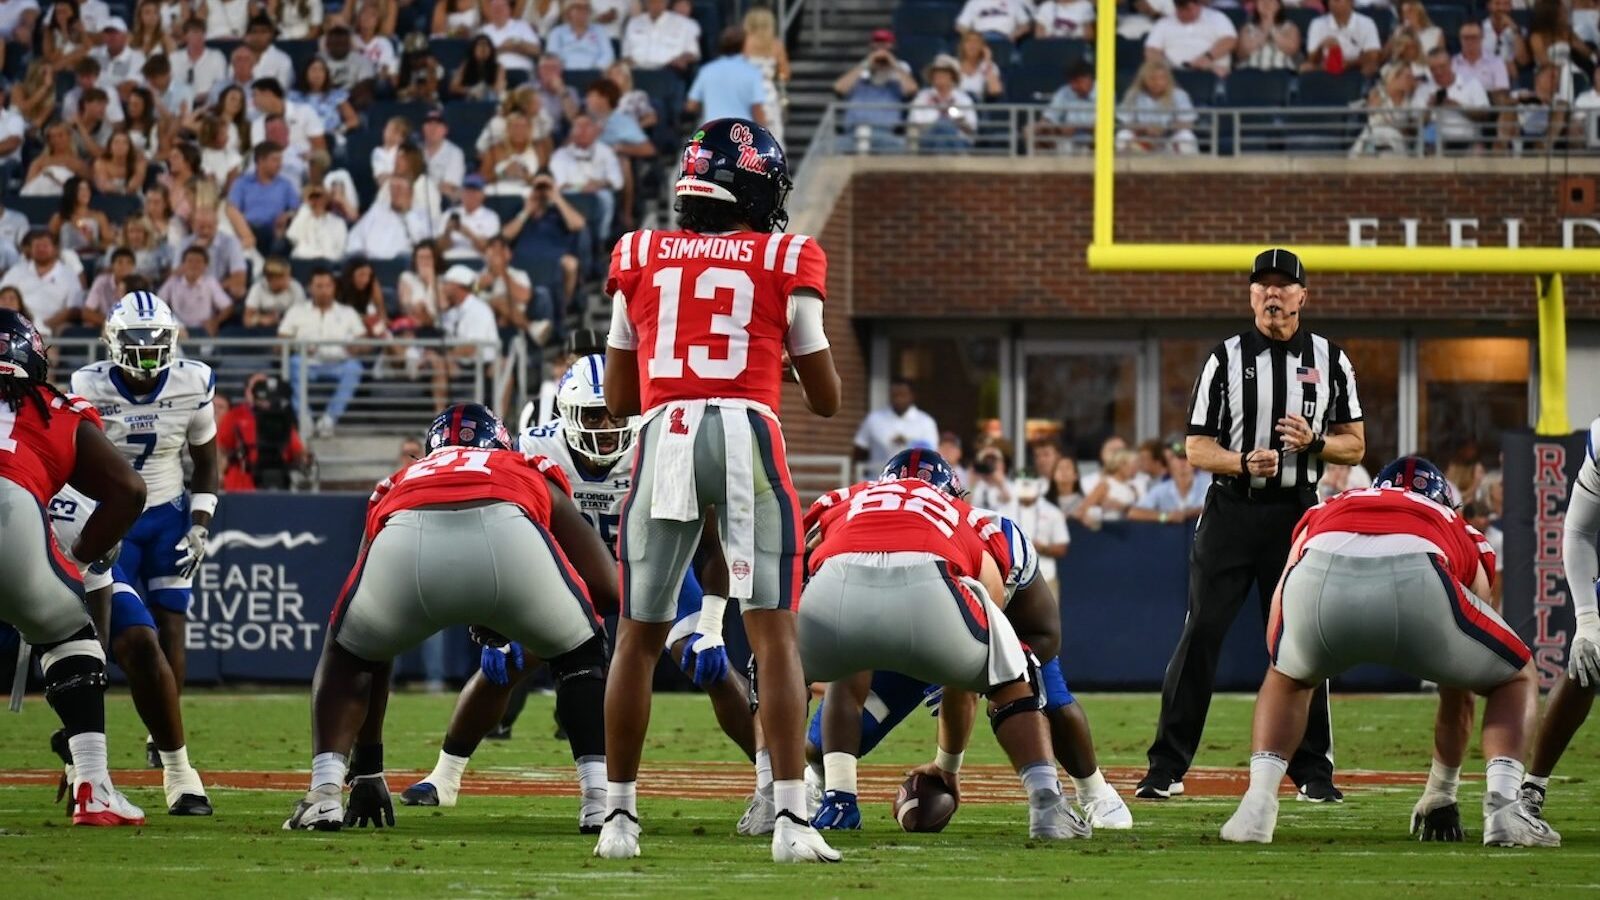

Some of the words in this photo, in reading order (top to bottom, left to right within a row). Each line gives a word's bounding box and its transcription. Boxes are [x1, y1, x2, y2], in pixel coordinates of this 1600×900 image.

[730, 123, 754, 145] Ole
[736, 144, 769, 175] Miss
[657, 237, 755, 262] SIMMONS
[648, 266, 755, 379] 13
[1245, 367, 1255, 379] S
[124, 414, 160, 423] GEORGIA
[1304, 401, 1315, 418] U
[130, 422, 154, 430] STATE
[126, 432, 157, 471] 7
[403, 450, 492, 481] 21
[574, 491, 615, 502] GEORGIA
[50, 497, 78, 524] 13
[847, 483, 960, 539] 62
[200, 563, 298, 590] EARL
[1534, 443, 1567, 692] REBELS
[184, 622, 321, 650] ESORT
